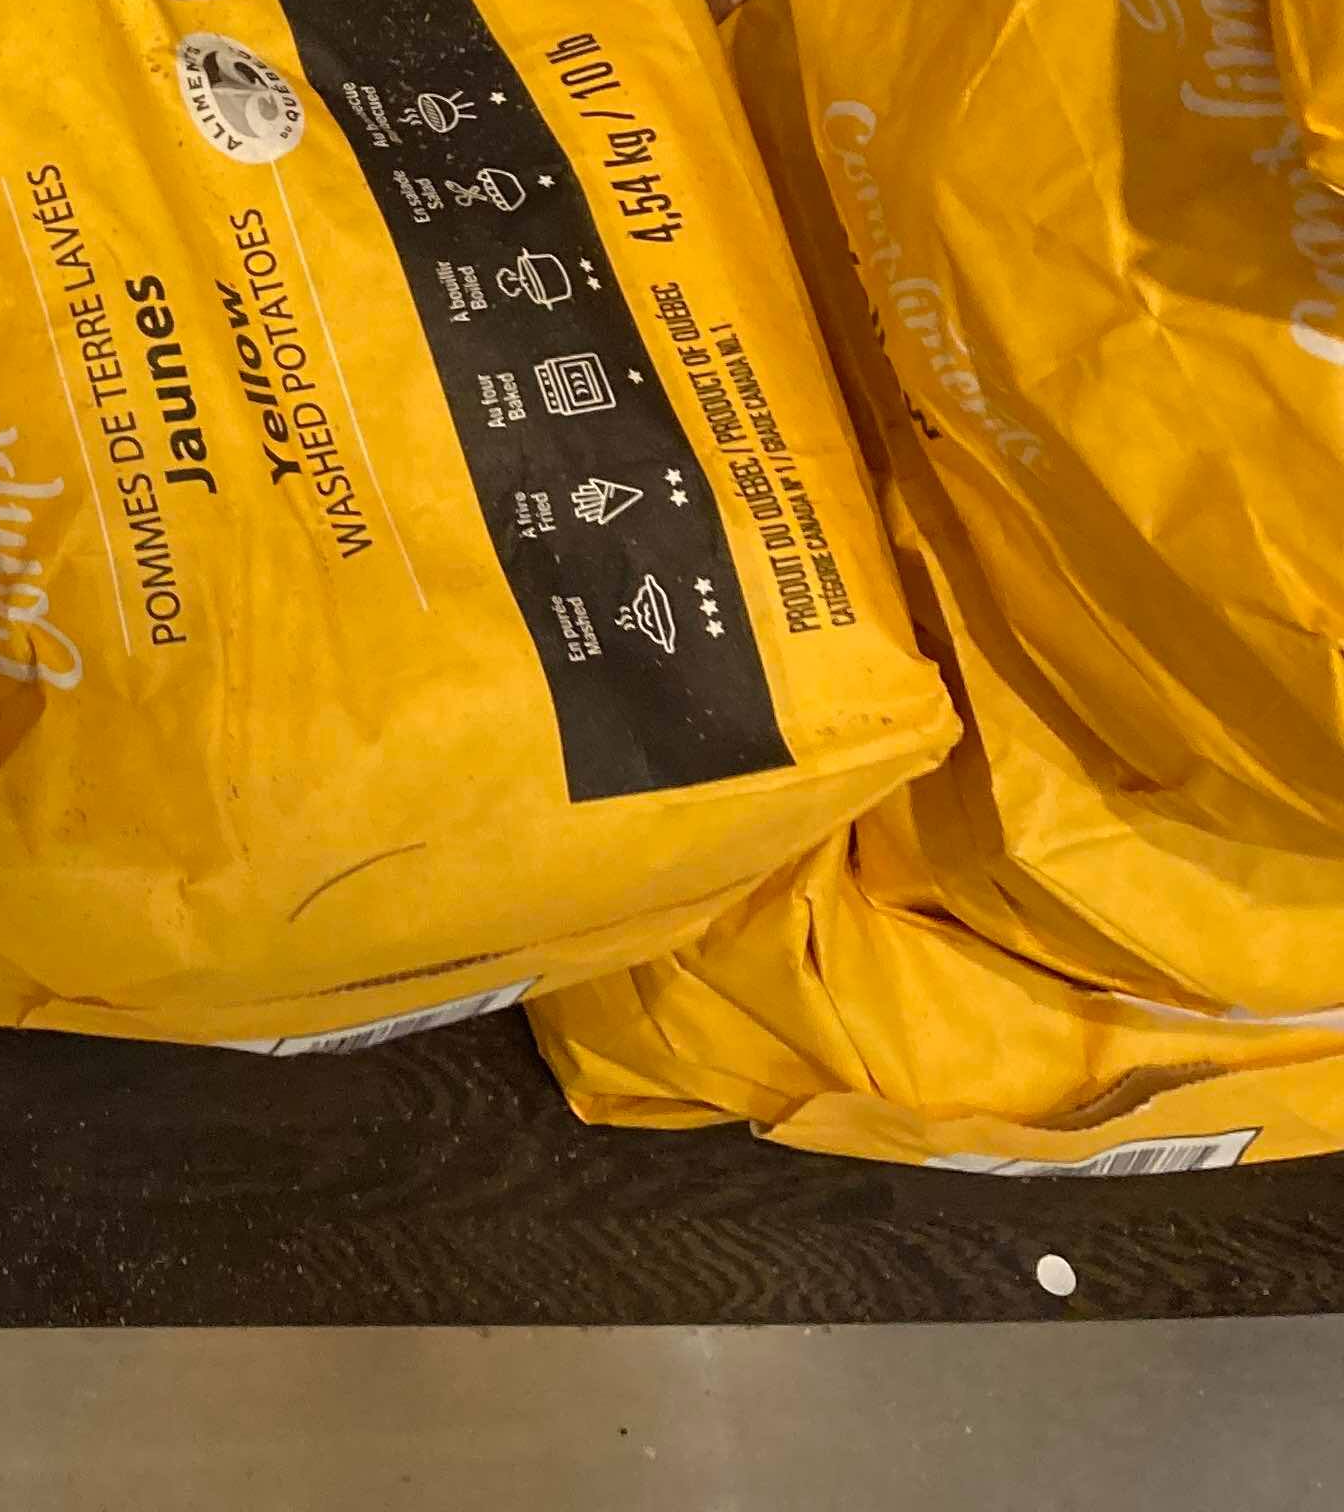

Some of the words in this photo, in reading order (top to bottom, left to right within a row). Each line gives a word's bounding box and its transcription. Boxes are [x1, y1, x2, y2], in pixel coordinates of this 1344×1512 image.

[546, 32, 602, 65] lb
[559, 60, 621, 101] 10
[578, 110, 636, 121] /
[602, 127, 657, 169] kg
[392, 169, 424, 208] salade
[415, 177, 445, 210] Salad
[609, 174, 683, 243] 4,54
[25, 164, 97, 293] LAVÉES
[413, 207, 431, 224] En
[229, 207, 316, 394] POTATOES
[435, 260, 467, 310] bouillir
[457, 265, 489, 311] Boiled
[650, 281, 701, 343] QUÉBEC
[708, 323, 733, 333] 1
[68, 292, 128, 408] TERRE
[677, 345, 712, 368] OF
[124, 272, 220, 496] Jaunes
[213, 277, 303, 486] Yellow
[477, 374, 500, 406] four
[495, 372, 528, 421] Baked
[725, 355, 768, 410] CANADA
[486, 407, 508, 429] Au
[687, 370, 748, 446] PRODUCT
[100, 411, 145, 464] DE
[292, 401, 373, 560] WASHED
[727, 460, 783, 521] QUÉBEC
[530, 491, 557, 533] Fried
[786, 492, 829, 551] CANADA
[115, 471, 188, 647] POMMES
[757, 523, 796, 552] DU
[550, 594, 581, 640] purée
[767, 555, 822, 634] PRODUIT
[566, 596, 603, 656] Mashed
[563, 640, 587, 663] En
